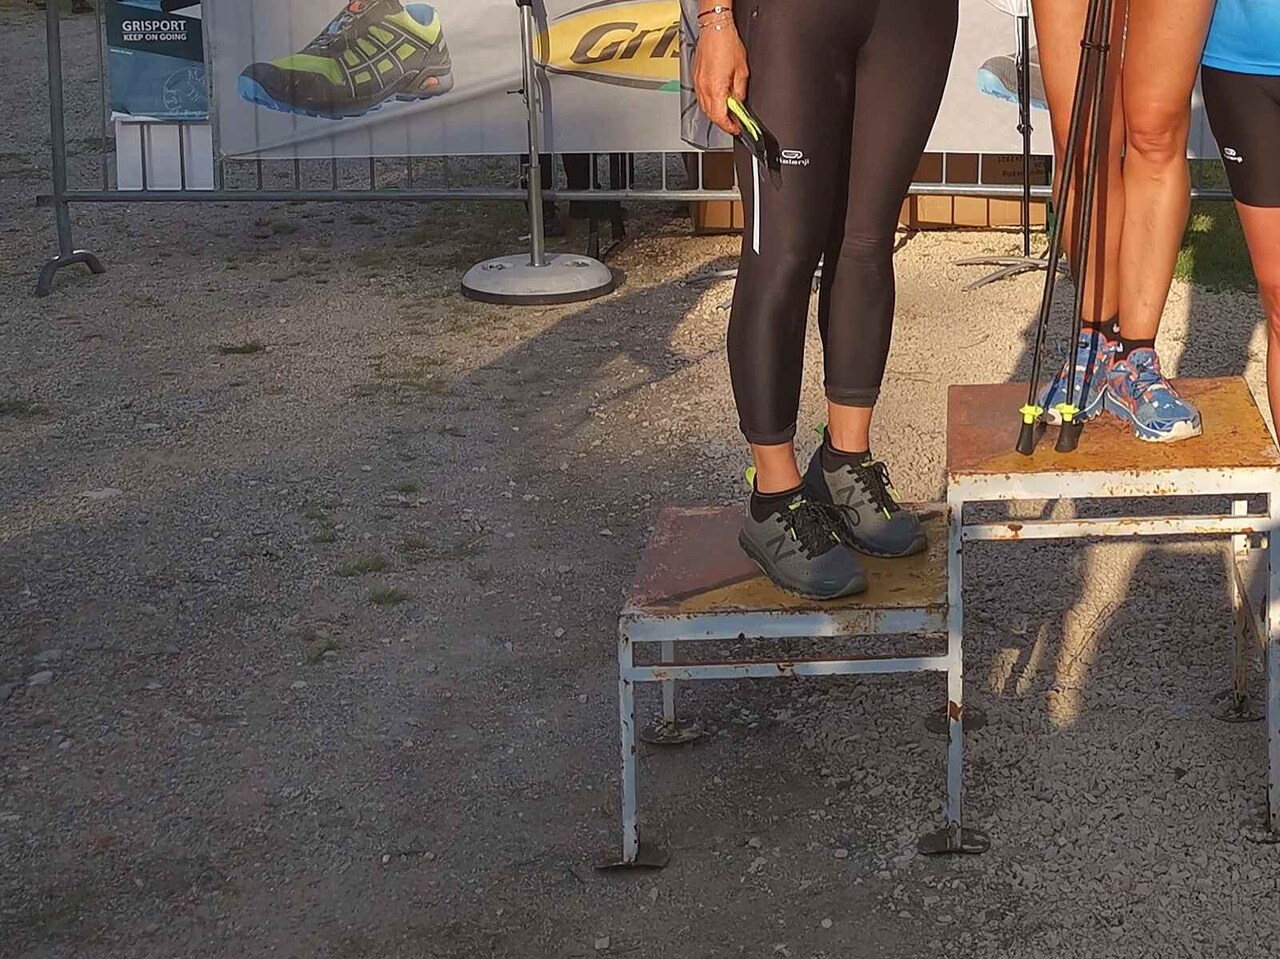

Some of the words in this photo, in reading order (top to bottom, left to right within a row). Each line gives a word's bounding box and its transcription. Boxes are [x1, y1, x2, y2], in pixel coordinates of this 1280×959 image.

[121, 20, 187, 32] GRISPORT
[159, 33, 187, 41] GOING
[570, 21, 681, 64] Gri
